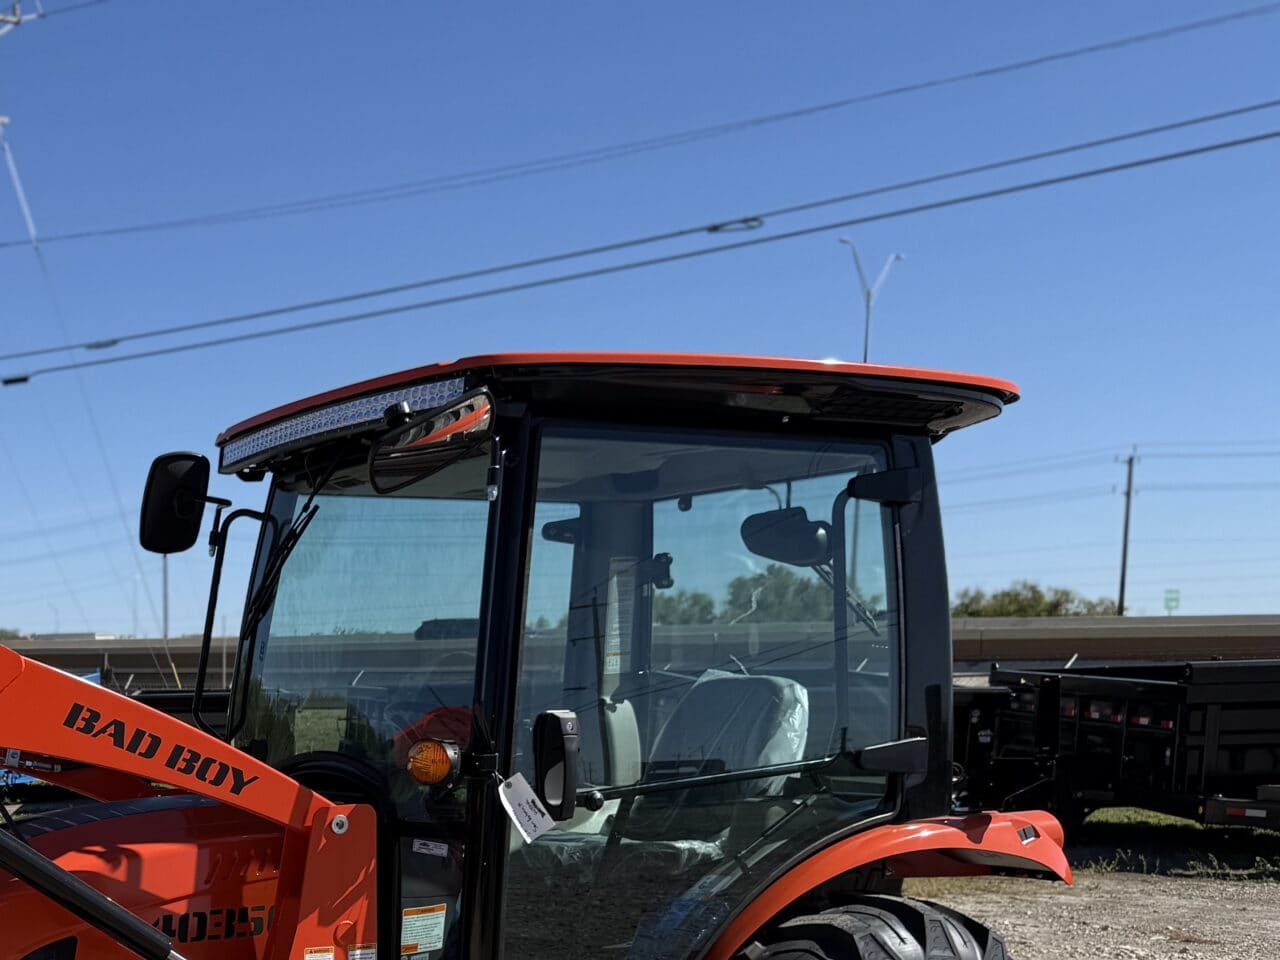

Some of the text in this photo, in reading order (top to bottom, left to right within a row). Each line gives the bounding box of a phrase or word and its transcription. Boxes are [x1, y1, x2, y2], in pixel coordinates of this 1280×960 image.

[62, 702, 261, 796] BAD BOY
[151, 904, 275, 944] 4035
